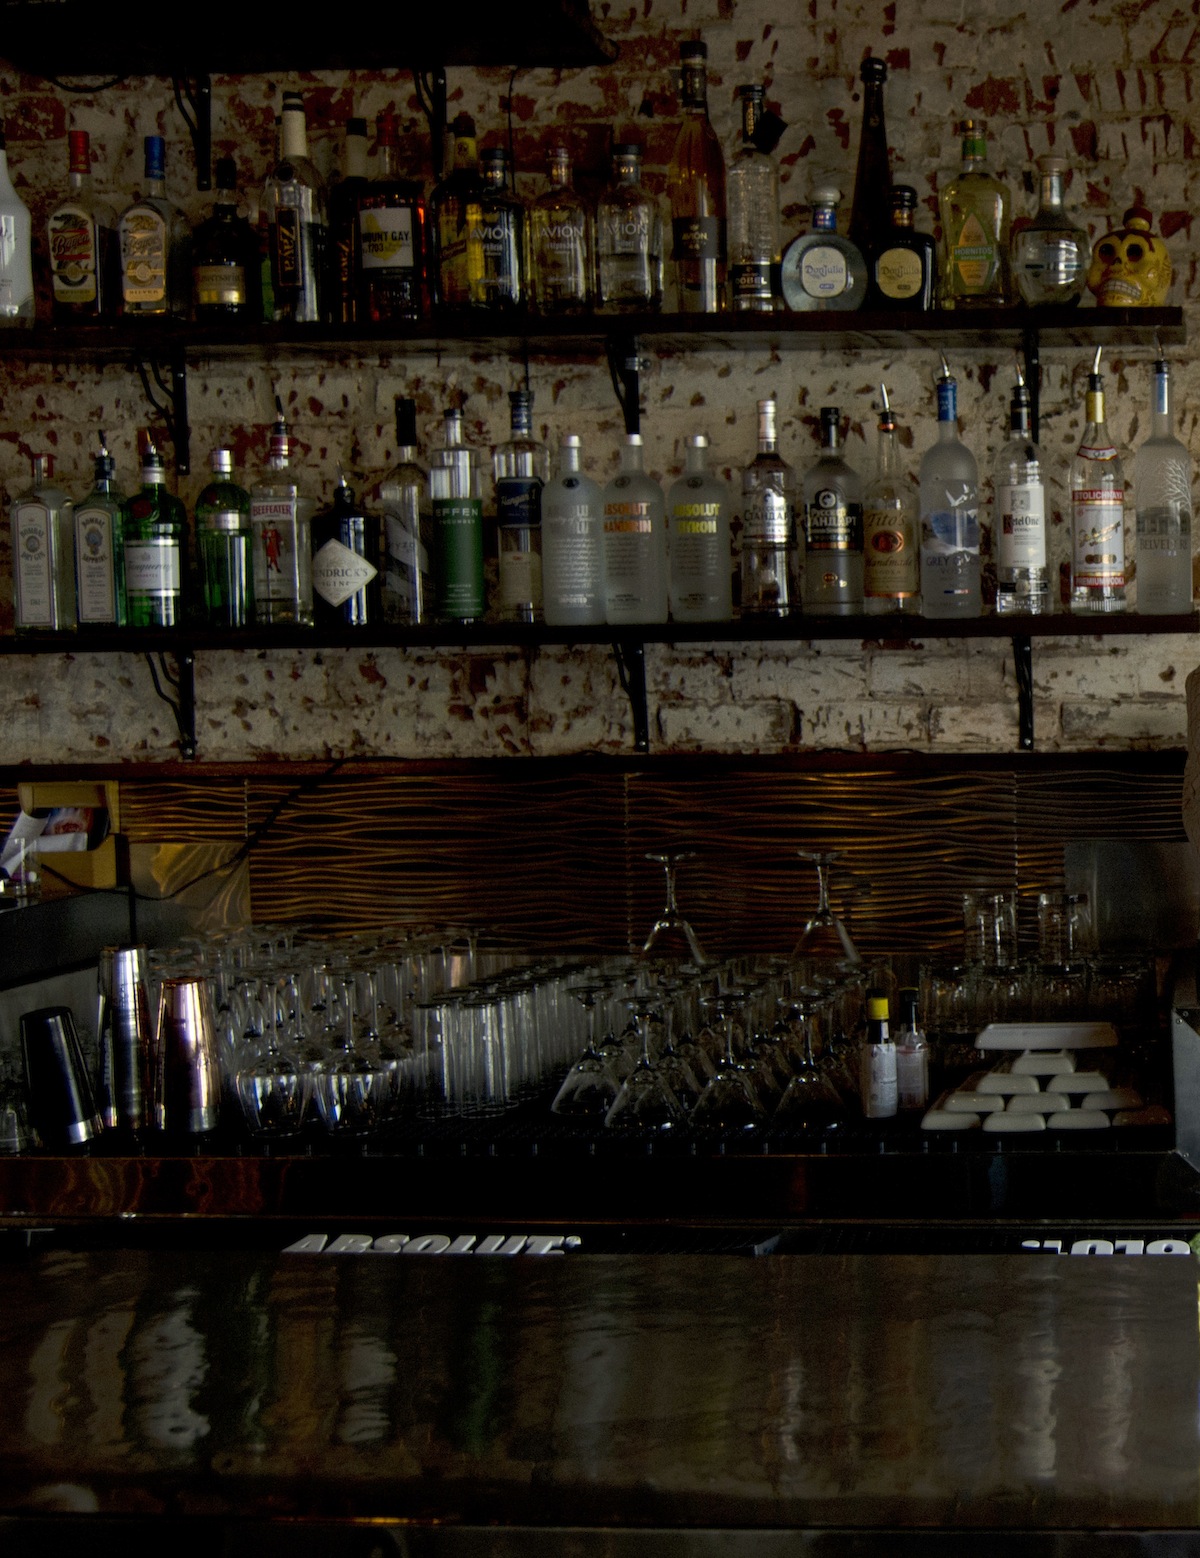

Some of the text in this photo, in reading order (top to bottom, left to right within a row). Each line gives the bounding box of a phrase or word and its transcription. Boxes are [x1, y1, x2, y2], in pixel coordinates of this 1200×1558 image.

[391, 231, 410, 241] GAY
[954, 247, 993, 255] HORNITOS
[252, 504, 292, 515] BEEFEATER
[868, 512, 907, 526] Tito's
[1025, 515, 1039, 526] One
[927, 556, 949, 567] GREY
[281, 1233, 567, 1254] ABSOLUT
